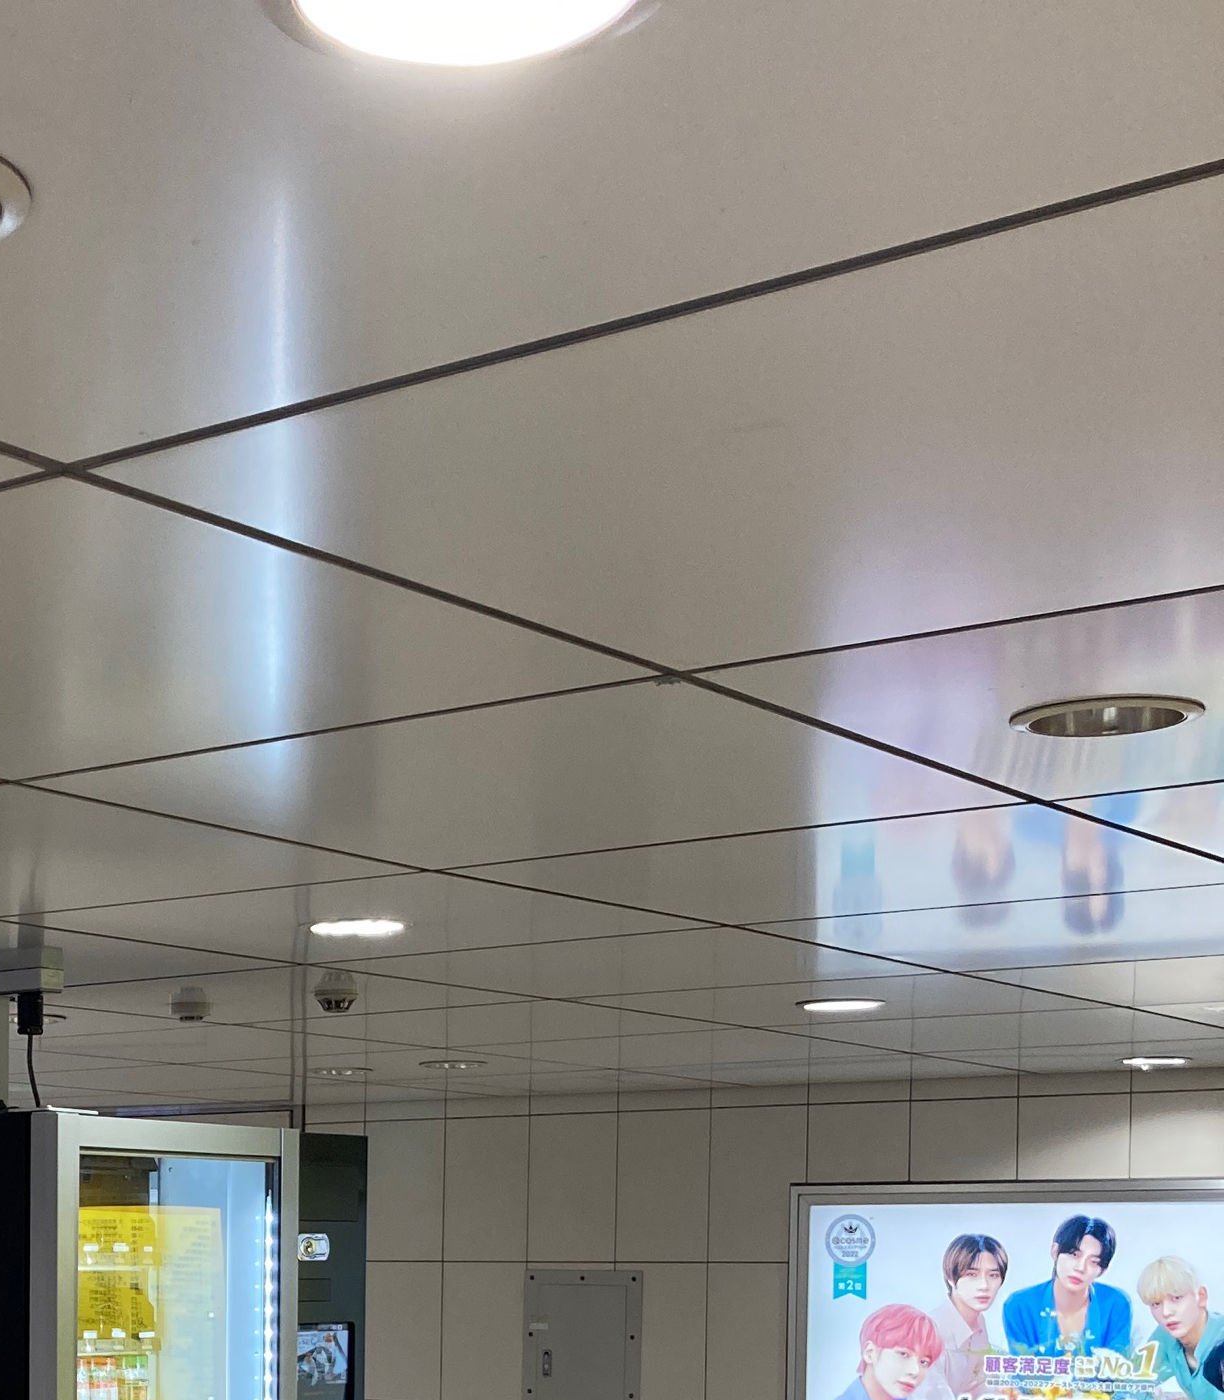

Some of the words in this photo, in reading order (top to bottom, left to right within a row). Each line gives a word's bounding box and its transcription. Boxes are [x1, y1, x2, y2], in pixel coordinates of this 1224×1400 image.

[832, 1236, 869, 1246] @cosme
[841, 1250, 859, 1258] 2022
[985, 1356, 1071, 1375] 顧客満足度
